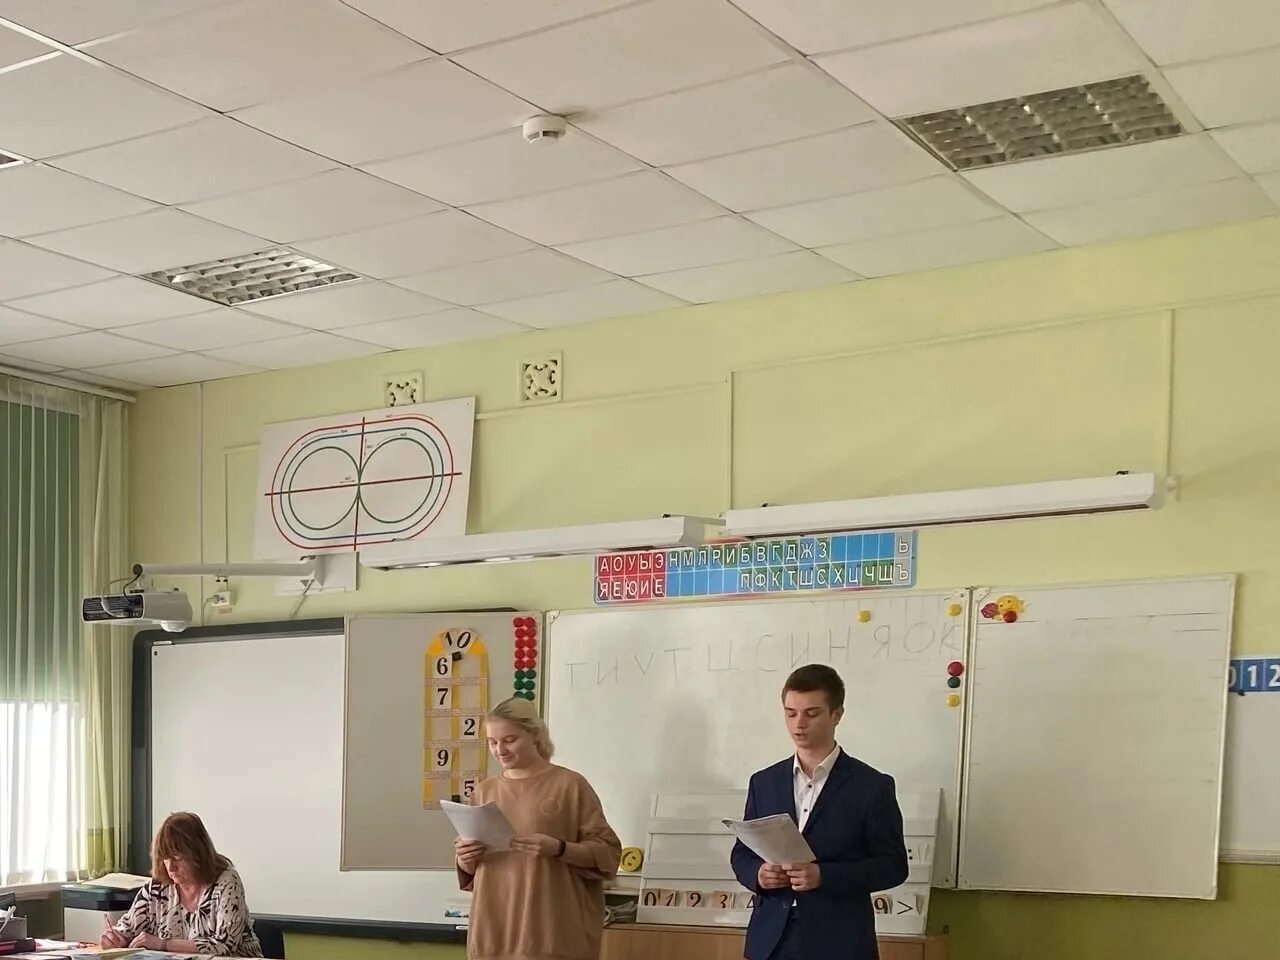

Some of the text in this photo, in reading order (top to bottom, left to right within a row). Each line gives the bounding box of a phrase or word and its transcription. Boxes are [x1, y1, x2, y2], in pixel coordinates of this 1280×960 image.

[444, 631, 472, 649] 10
[436, 656, 449, 675] 6
[437, 687, 448, 705] 7
[463, 718, 476, 736] 2
[437, 749, 449, 766] 9
[464, 780, 475, 797] 5
